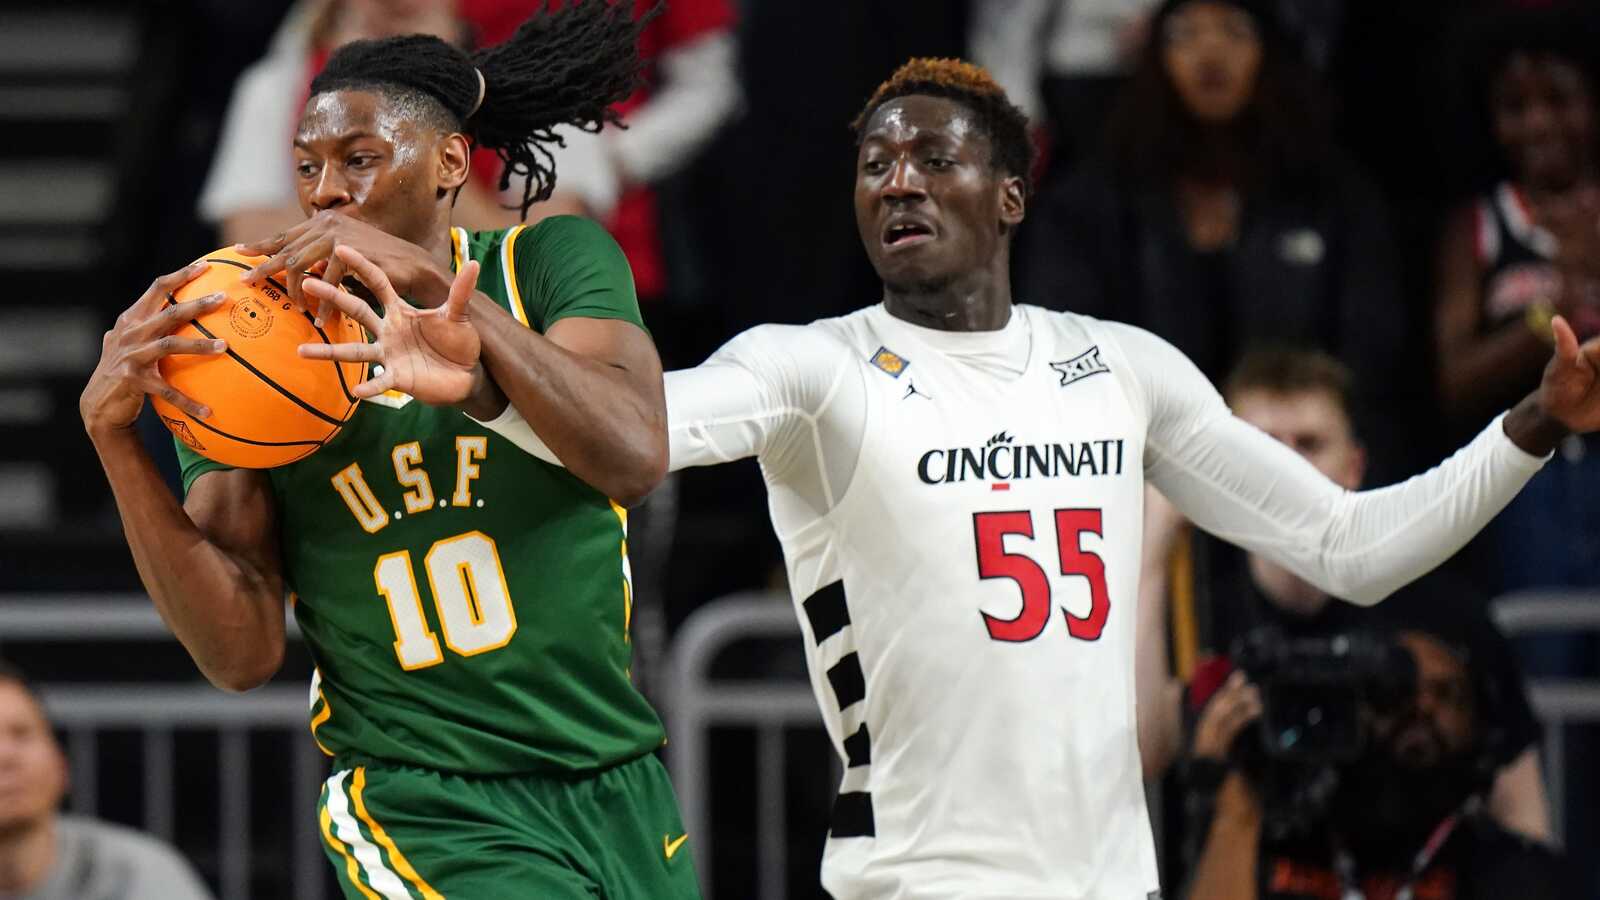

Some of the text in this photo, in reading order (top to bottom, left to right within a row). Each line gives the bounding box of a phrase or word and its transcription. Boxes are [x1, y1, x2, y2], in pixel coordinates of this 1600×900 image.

[331, 436, 485, 534] U.S.F.
[917, 433, 1124, 486] CINCINNATI
[373, 530, 518, 672] 10
[972, 507, 1112, 643] 55
